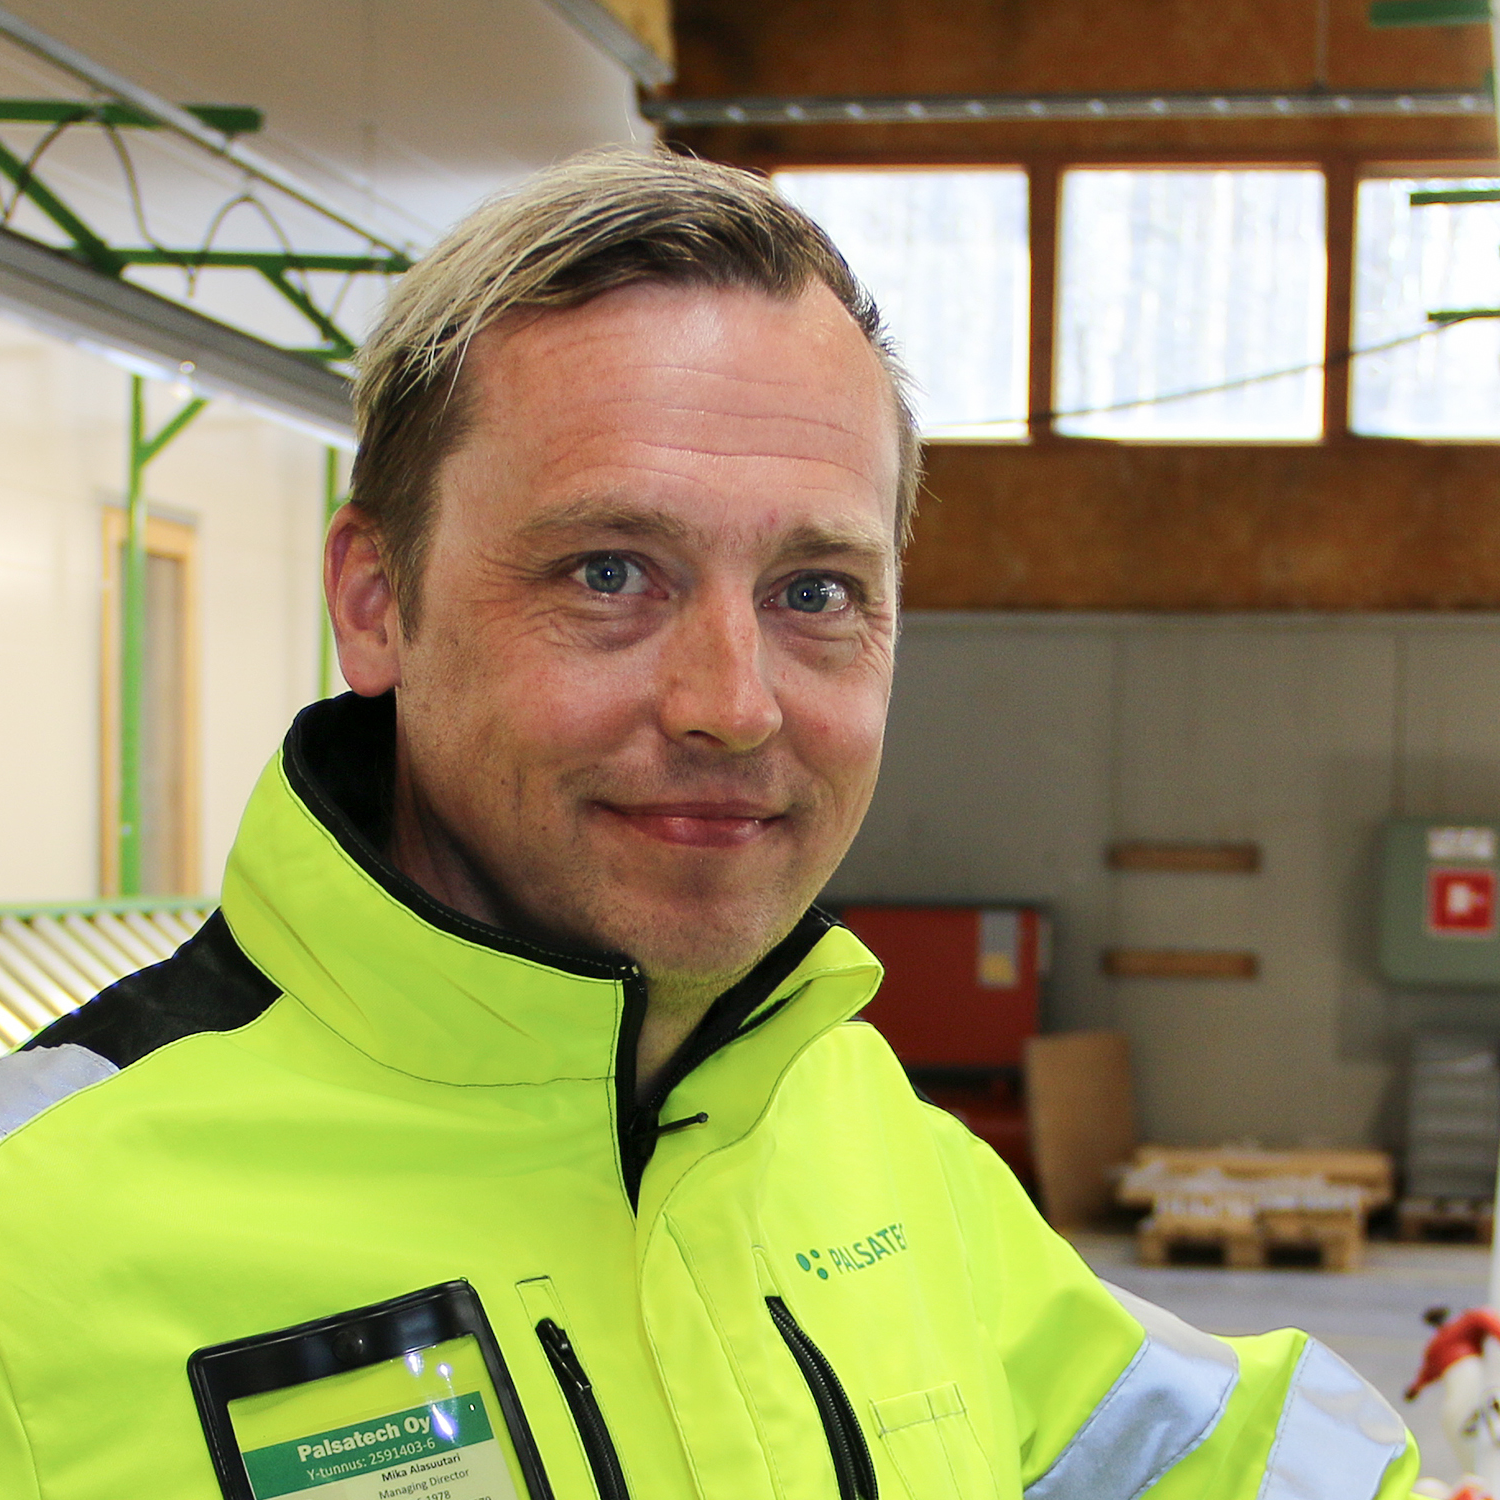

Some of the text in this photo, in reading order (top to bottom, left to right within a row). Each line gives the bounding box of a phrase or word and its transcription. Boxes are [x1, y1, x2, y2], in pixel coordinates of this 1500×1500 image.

[297, 1416, 431, 1462] Palsatech Oy
[306, 1437, 436, 1481] Y-tunnus: 2591403-6
[381, 1453, 461, 1482] Mika Alasuutari
[378, 1468, 470, 1500] Managing Director
